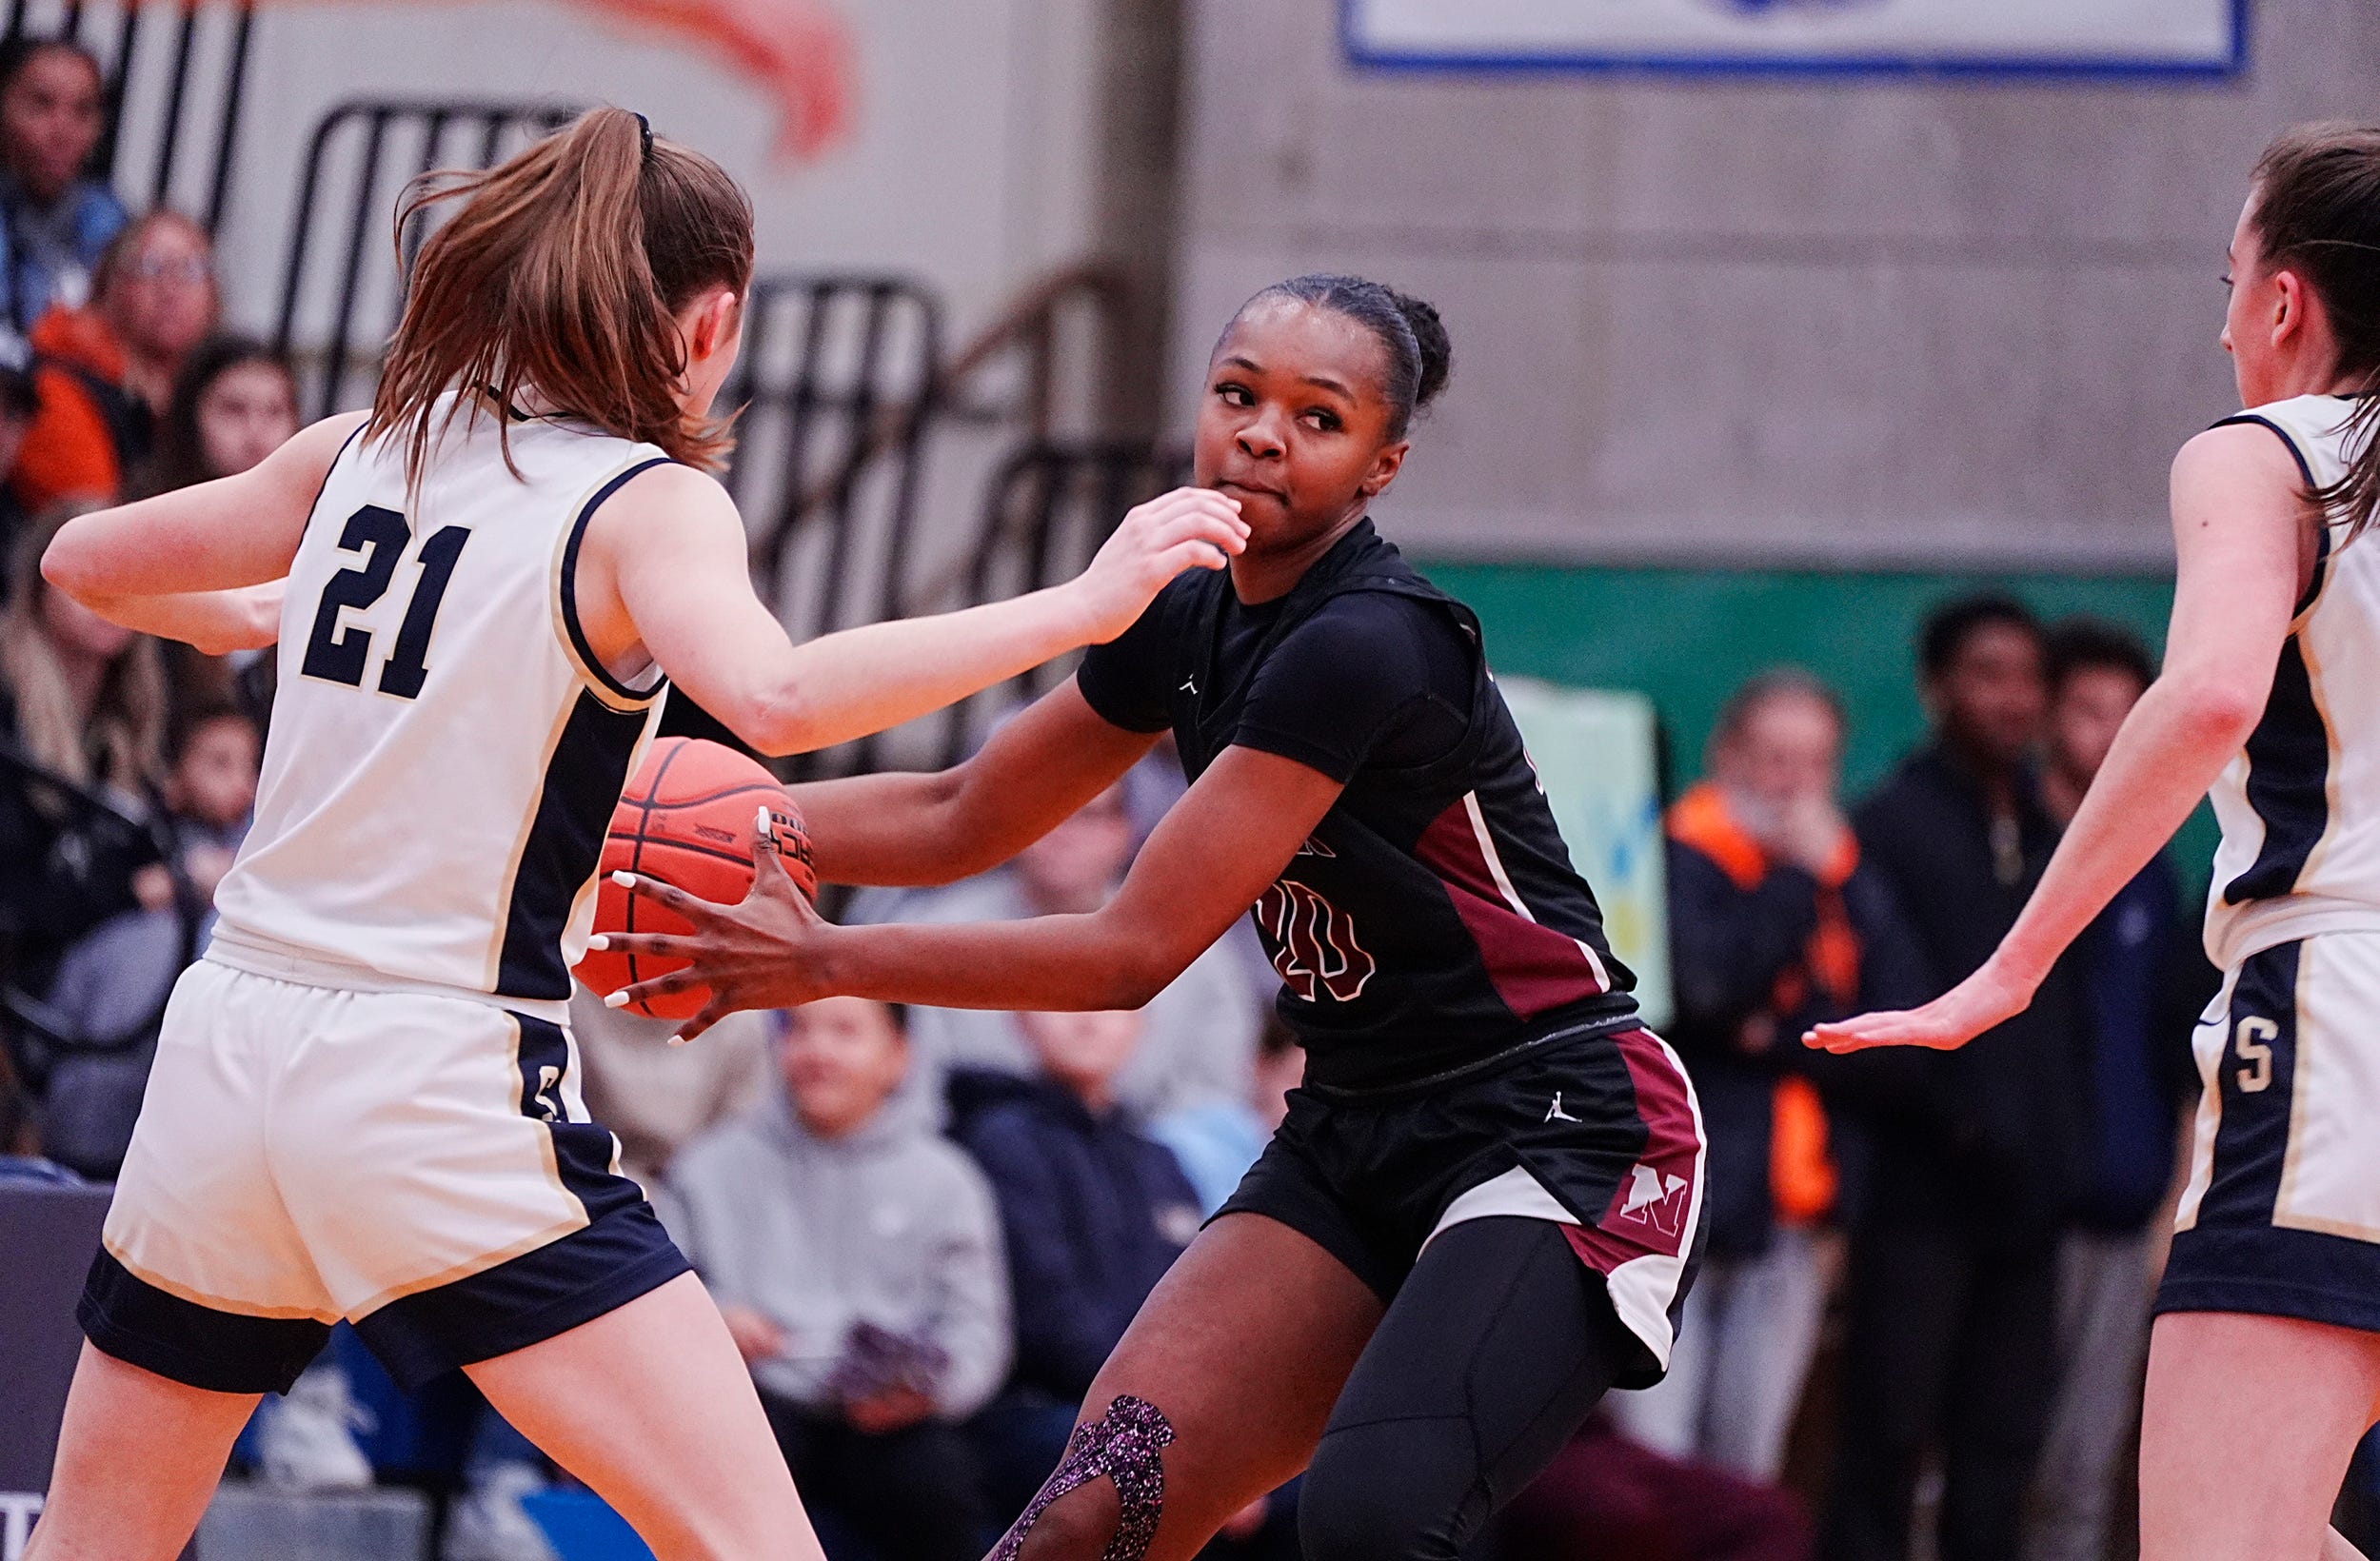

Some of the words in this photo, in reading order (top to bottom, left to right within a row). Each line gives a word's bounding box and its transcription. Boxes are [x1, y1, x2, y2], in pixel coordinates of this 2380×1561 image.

[300, 502, 473, 701] 21
[2234, 1014, 2280, 1094] S
[1619, 1162, 1688, 1237] N
